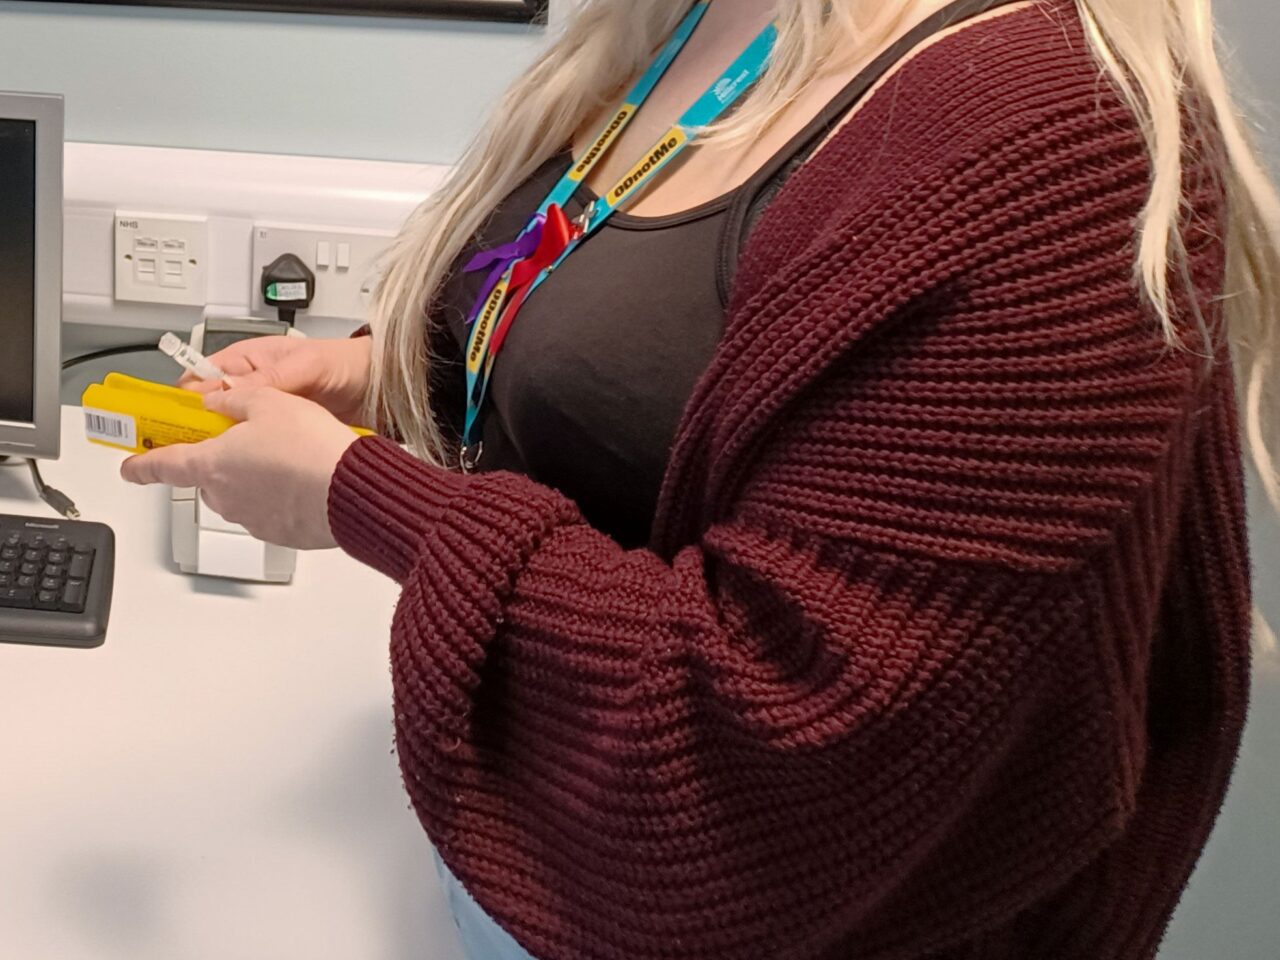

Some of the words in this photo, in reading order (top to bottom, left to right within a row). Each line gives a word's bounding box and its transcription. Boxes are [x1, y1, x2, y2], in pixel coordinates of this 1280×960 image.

[576, 110, 628, 173] ODnotMe
[613, 136, 678, 198] ODnotMe
[120, 221, 138, 230] NHS
[470, 288, 503, 362] ODnotMe
